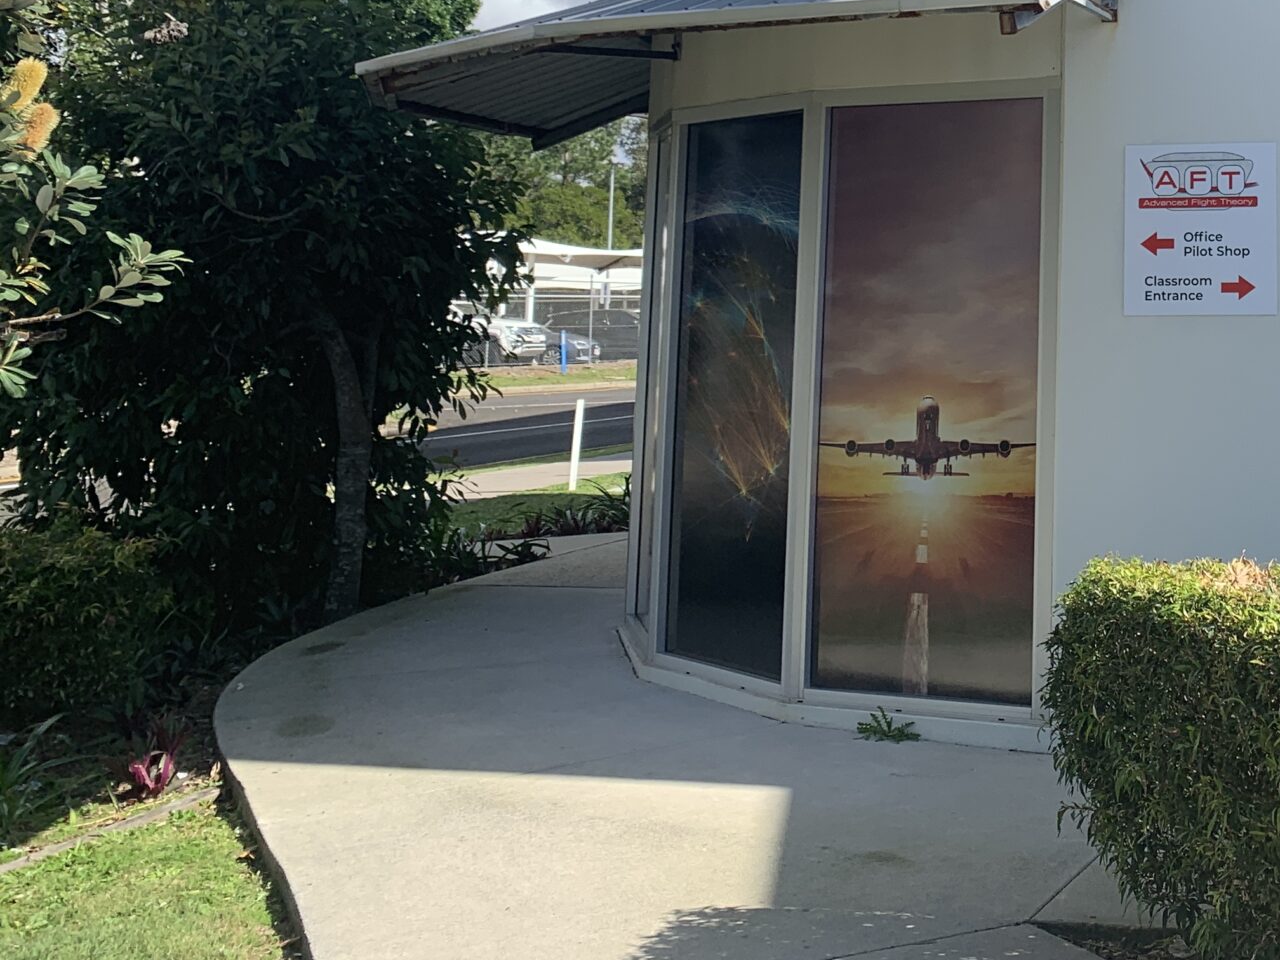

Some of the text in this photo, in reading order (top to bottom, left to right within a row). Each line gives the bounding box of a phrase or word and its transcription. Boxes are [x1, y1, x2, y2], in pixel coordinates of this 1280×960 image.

[1143, 198, 1253, 207] Advanced Flight Theory
[1183, 231, 1223, 242] Office
[1183, 246, 1250, 259] Pilot Shop
[1144, 275, 1212, 287] Classroom
[1144, 290, 1203, 301] Entrance
